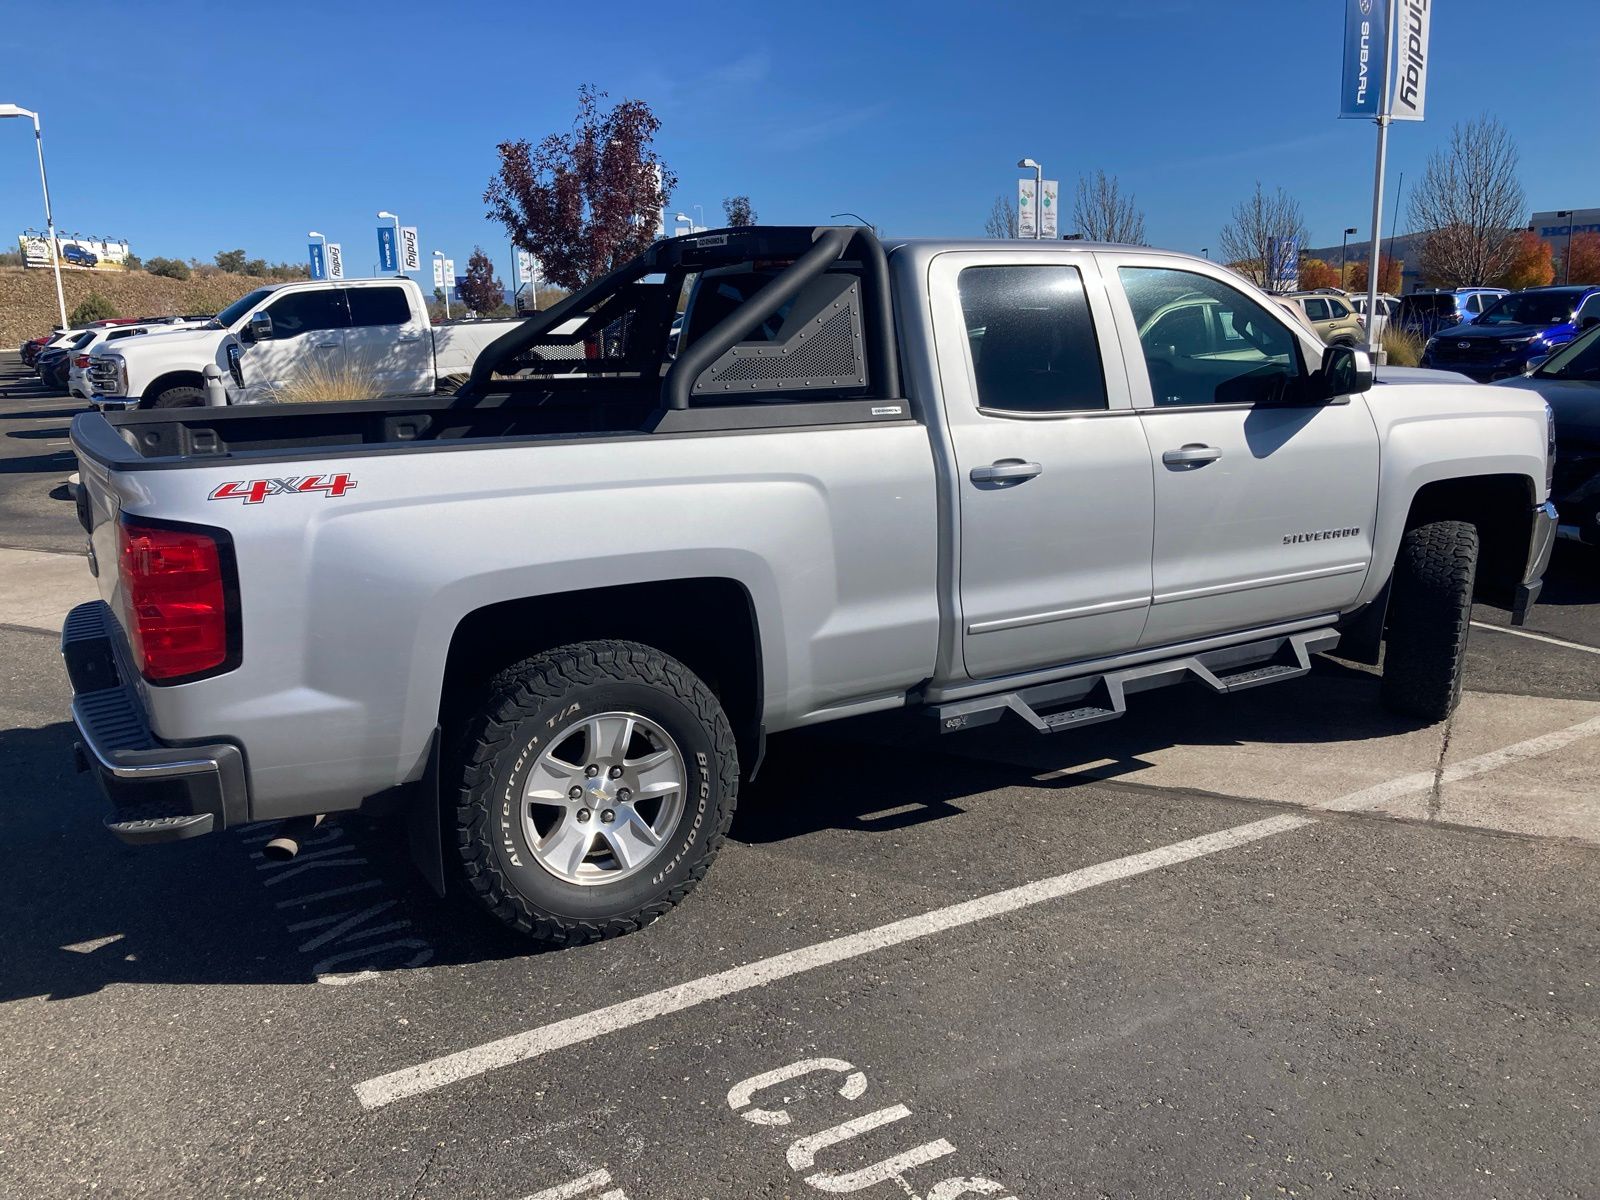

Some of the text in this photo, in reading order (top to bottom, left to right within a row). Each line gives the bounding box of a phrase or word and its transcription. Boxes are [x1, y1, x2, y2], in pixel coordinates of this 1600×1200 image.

[1356, 21, 1370, 105] SUBARU
[329, 246, 340, 277] Findlay
[403, 230, 417, 268] Findlay
[1282, 527, 1360, 545] SILVERADO
[546, 702, 581, 728] T/A
[501, 735, 538, 867] All-Terrain
[652, 752, 710, 885] BFGoodrich
